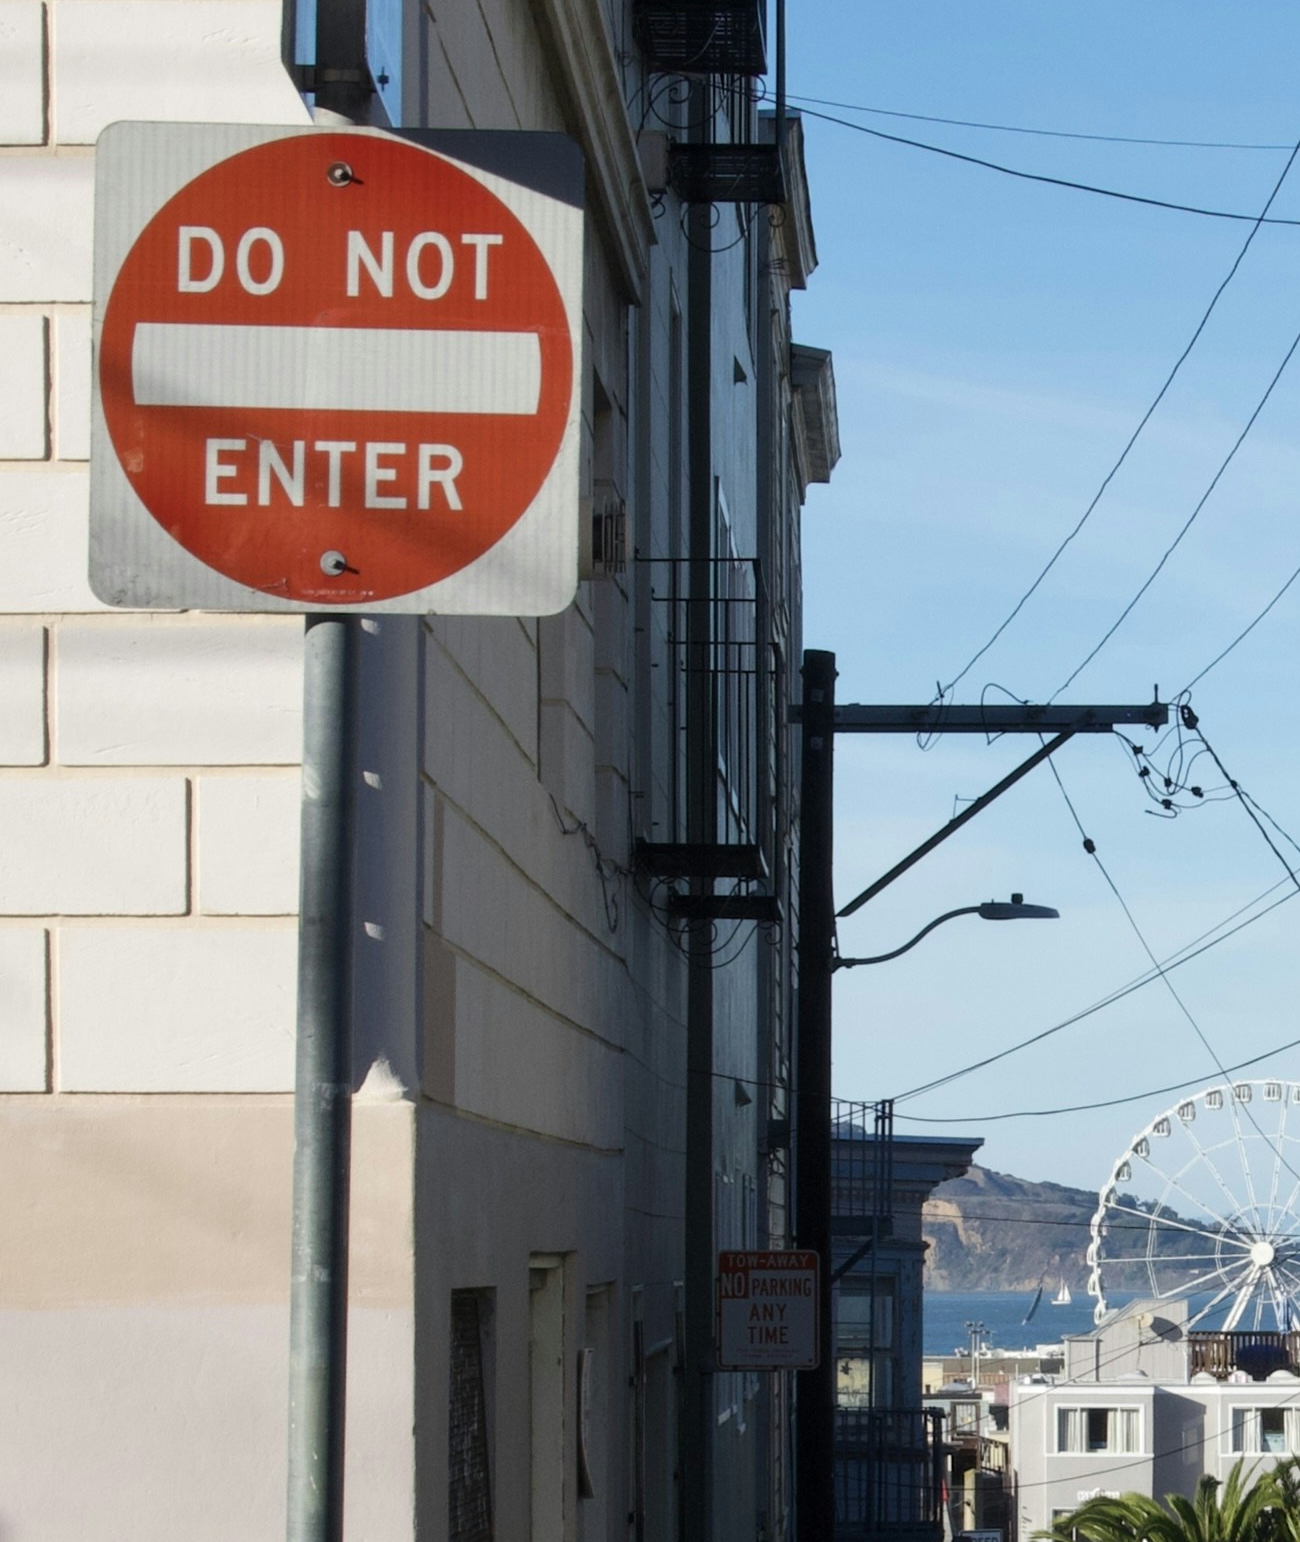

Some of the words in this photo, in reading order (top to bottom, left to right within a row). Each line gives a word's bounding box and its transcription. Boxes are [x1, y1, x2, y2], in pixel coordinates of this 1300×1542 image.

[177, 225, 285, 297] DO
[346, 230, 504, 302] NOT
[204, 438, 464, 511] ENTER
[727, 1254, 809, 1268] TOW-AWAY
[721, 1272, 745, 1297] NO
[752, 1278, 812, 1296] PARKING
[749, 1303, 787, 1321] ANY
[747, 1327, 789, 1344] TIME
